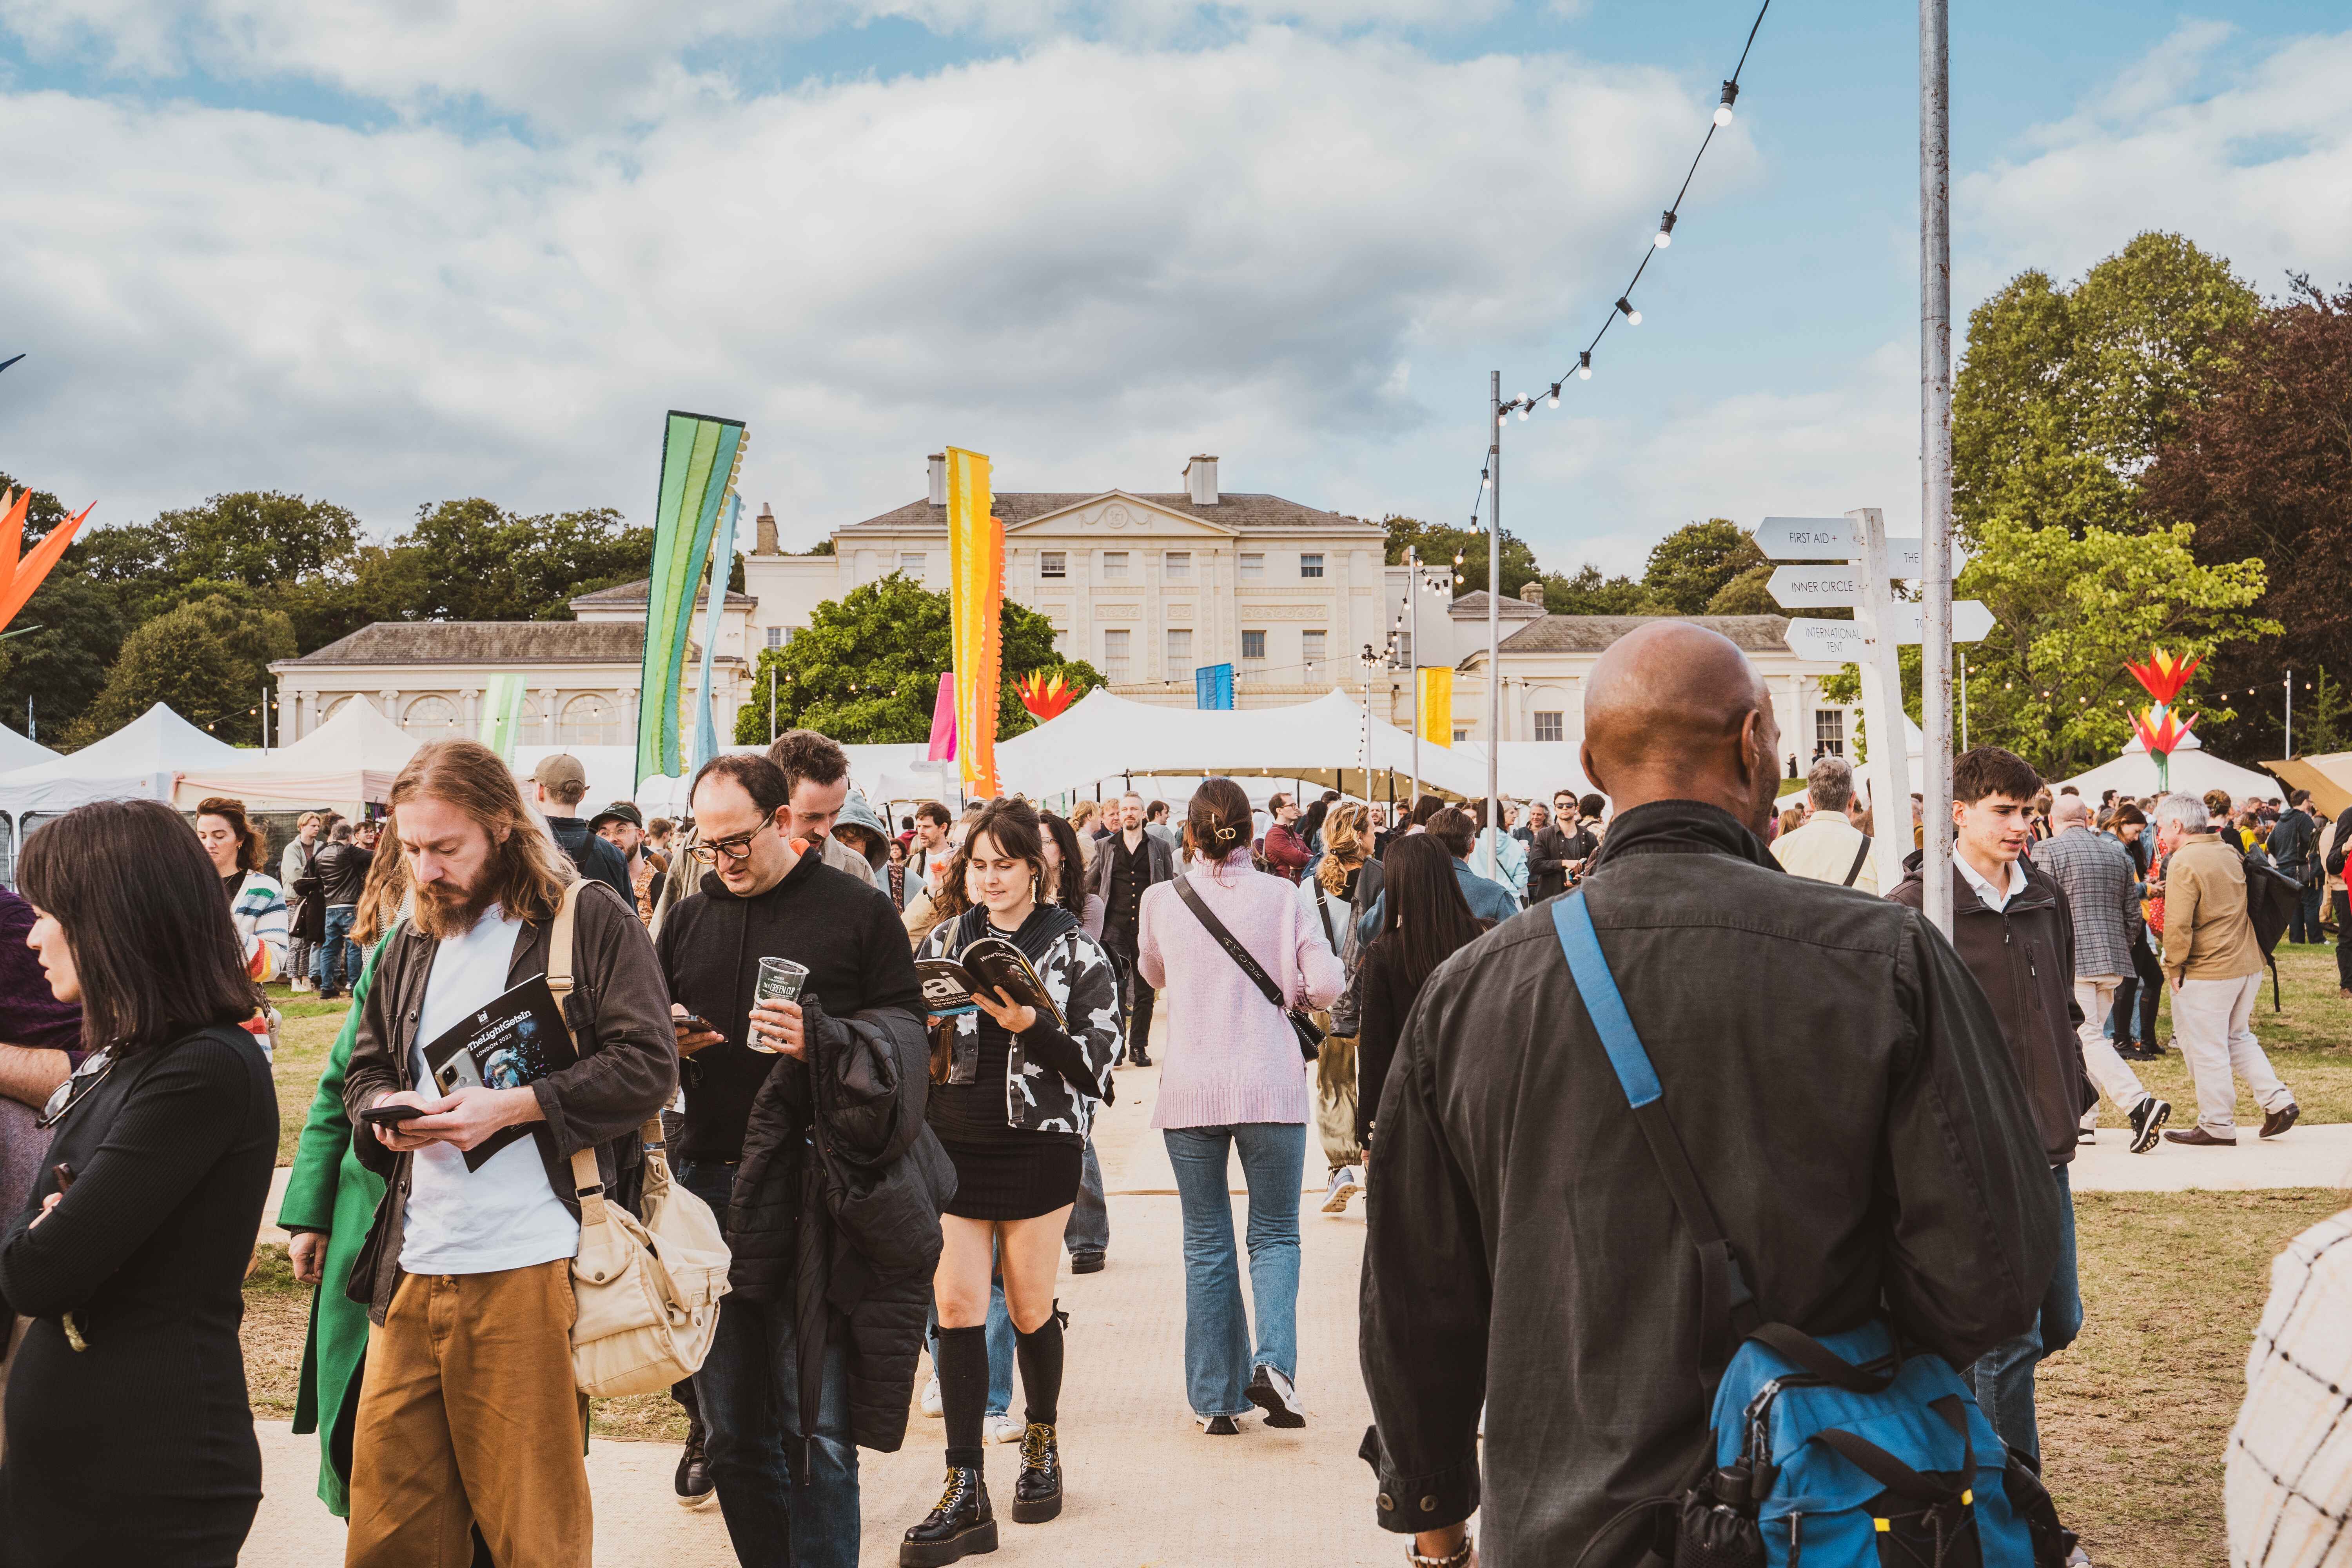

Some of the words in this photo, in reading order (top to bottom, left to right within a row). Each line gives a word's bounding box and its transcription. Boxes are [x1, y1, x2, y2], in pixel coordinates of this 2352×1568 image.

[1789, 532, 1810, 544] FIRST
[1814, 533, 1829, 544] AID
[1904, 553, 1919, 563] THE
[1791, 582, 1818, 592] INNER
[1821, 581, 1853, 592] CIRCLE
[1915, 619, 1923, 629] T
[1805, 627, 1861, 639] INTERNATIONAL
[1826, 641, 1843, 652] TENT
[1223, 937, 1263, 979] AMOUR
[770, 983, 786, 995] GREEN
[786, 987, 795, 995] CUP
[466, 1010, 532, 1051] TheLightGetsIn
[476, 1041, 499, 1058] LONDON
[499, 1033, 512, 1044] 2023
